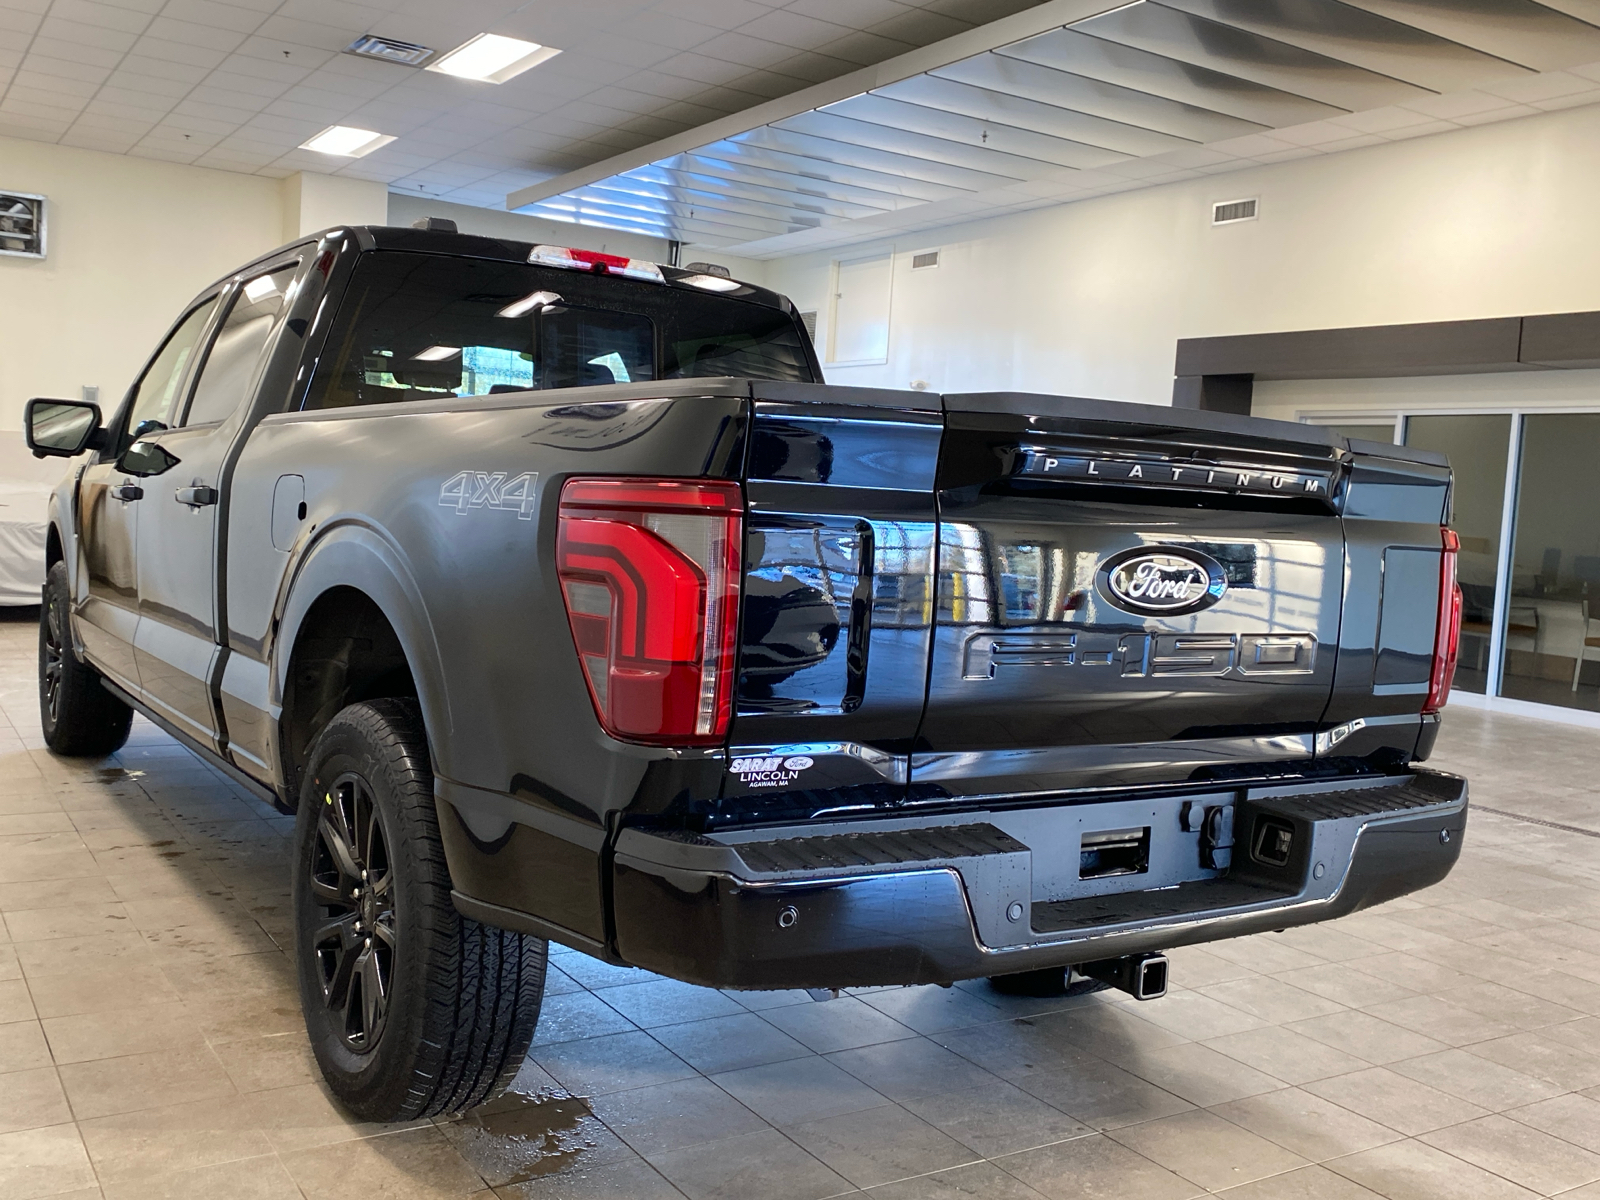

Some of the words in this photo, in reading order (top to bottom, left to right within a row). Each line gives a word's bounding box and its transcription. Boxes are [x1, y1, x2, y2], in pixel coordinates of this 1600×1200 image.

[1043, 457, 1319, 492] PLATINUM
[1128, 561, 1194, 599] Ford
[962, 632, 1318, 680] F-150
[729, 757, 783, 773] SARAT
[787, 757, 810, 769] Ford
[740, 770, 799, 782] LINCOLN
